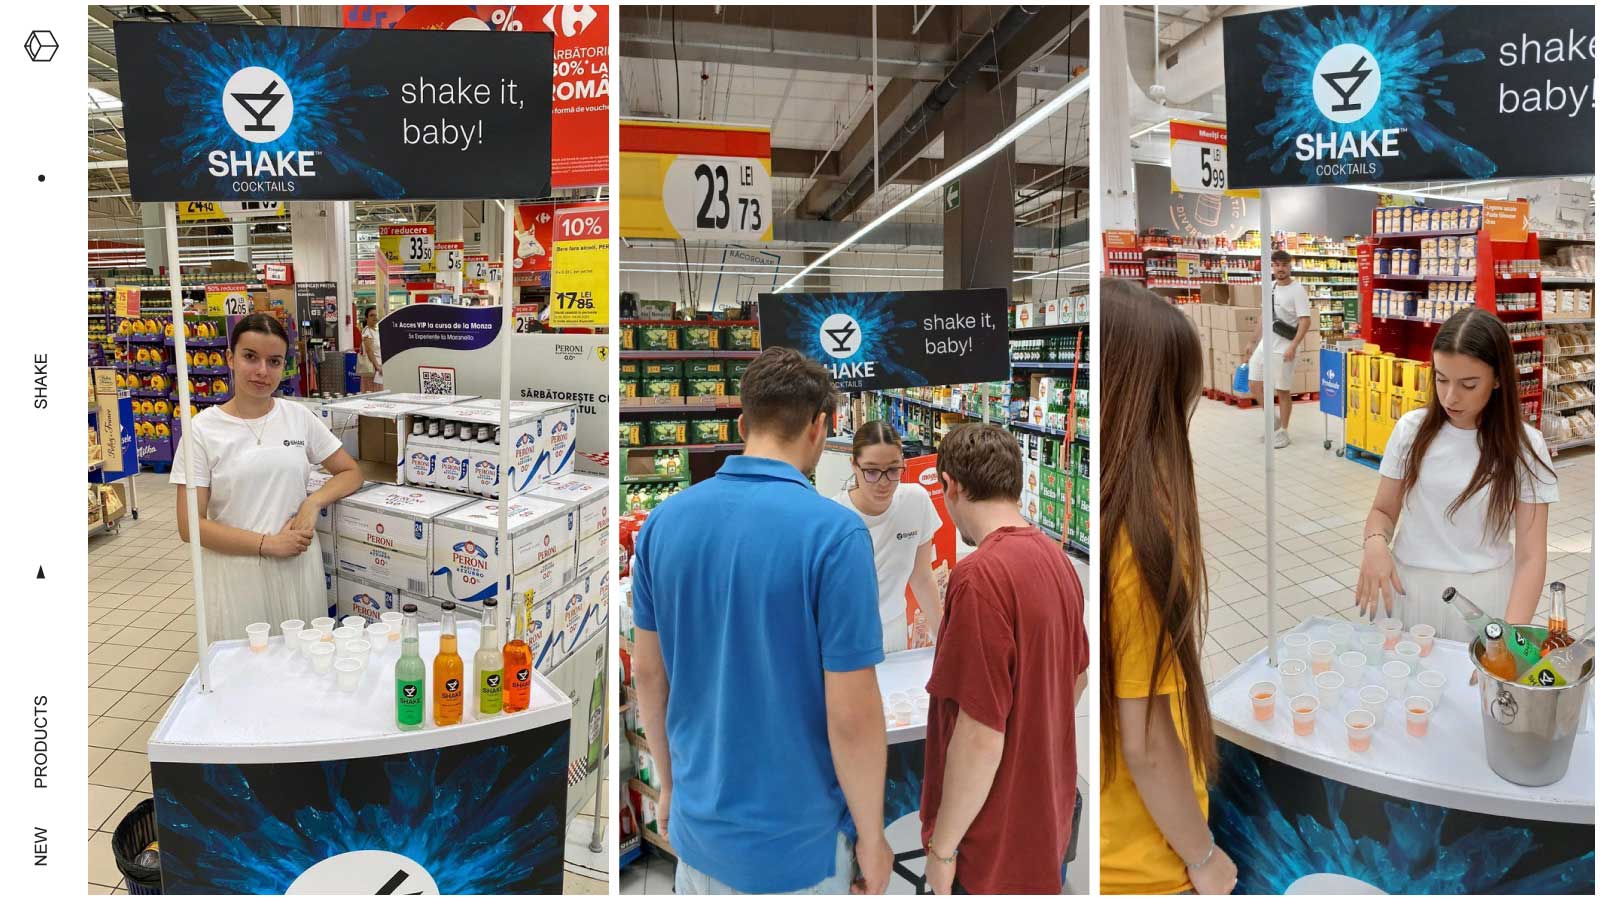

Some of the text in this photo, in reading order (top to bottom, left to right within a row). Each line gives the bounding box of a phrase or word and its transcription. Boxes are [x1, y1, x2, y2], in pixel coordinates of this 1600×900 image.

[401, 76, 524, 109] shake it,
[403, 118, 482, 151] baby!
[1201, 147, 1212, 187] 5
[1314, 162, 1375, 177] COCKTAILS
[232, 181, 296, 192] COCKTAILS
[1213, 168, 1225, 189] 99
[694, 163, 753, 230] 23 LEI
[738, 198, 762, 231] 73
[391, 226, 428, 235] reducere
[562, 216, 602, 237] 10%
[410, 237, 423, 260] 33
[424, 248, 432, 260] 50
[448, 251, 454, 270] 5
[225, 298, 238, 315] 12
[557, 292, 577, 309] 17
[577, 299, 594, 309] 85
[237, 304, 247, 315] 05
[399, 321, 417, 330] Acces
[417, 321, 427, 330] VIP
[427, 321, 434, 329] la
[453, 322, 461, 330] de
[462, 322, 470, 330] la
[471, 322, 492, 331] Monza
[923, 312, 996, 331] shake it,
[555, 344, 583, 353] PERONI
[925, 337, 974, 357] baby!
[367, 533, 393, 548] PERONI
[452, 552, 488, 571] PERONI
[537, 545, 557, 561] PERONI
[353, 603, 381, 620] PERONI
